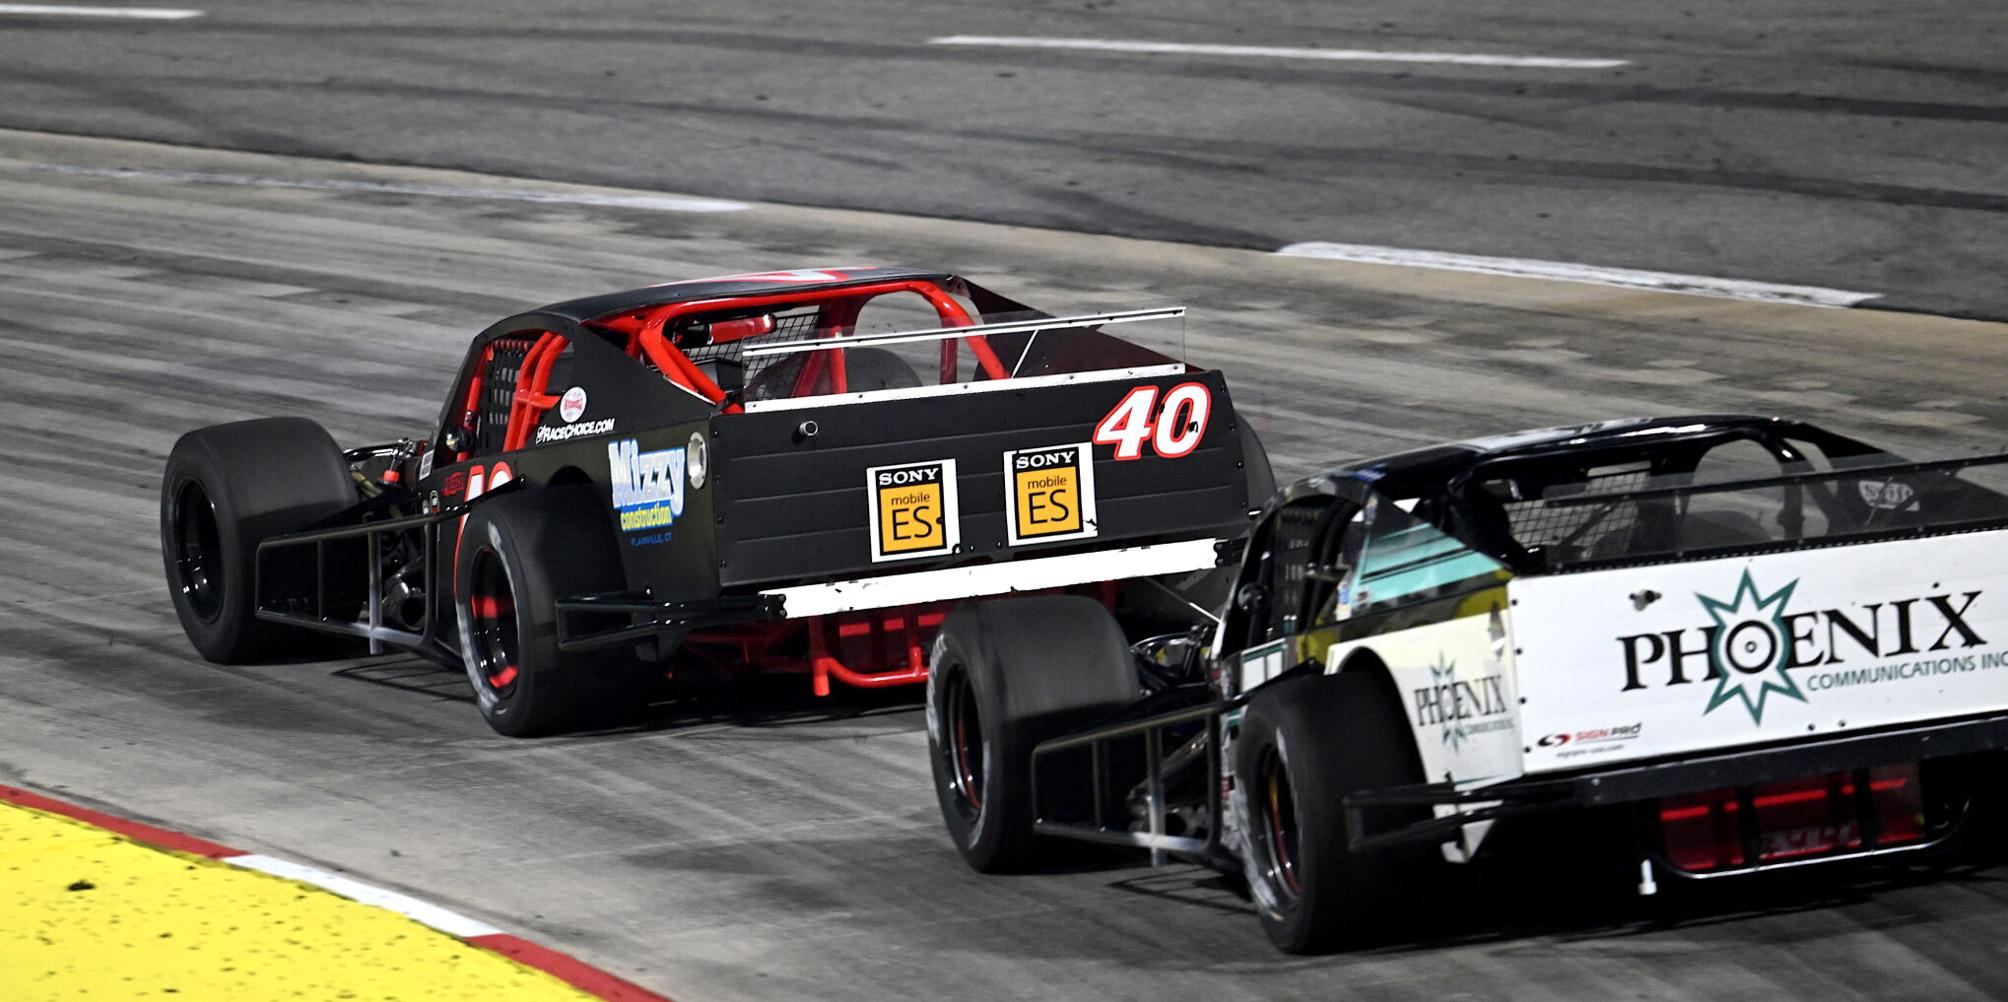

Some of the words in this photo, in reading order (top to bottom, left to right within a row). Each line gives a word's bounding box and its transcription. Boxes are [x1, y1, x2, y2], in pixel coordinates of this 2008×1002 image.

[1092, 382, 1211, 461] 40
[608, 439, 686, 516] Mizzy
[879, 467, 939, 486] SONY
[1016, 451, 1075, 469] SONY
[891, 491, 930, 505] mobile
[1027, 475, 1067, 489] mobile
[621, 502, 672, 530] construction
[892, 506, 932, 541] ES
[1029, 489, 1069, 524] ES
[1616, 590, 1988, 692] PHOENIX
[1807, 656, 1976, 692] COMMUNICATIONS
[1414, 674, 1507, 727] PHOENIX
[1575, 728, 1608, 741] SIGN
[1611, 722, 1642, 736] PRO
